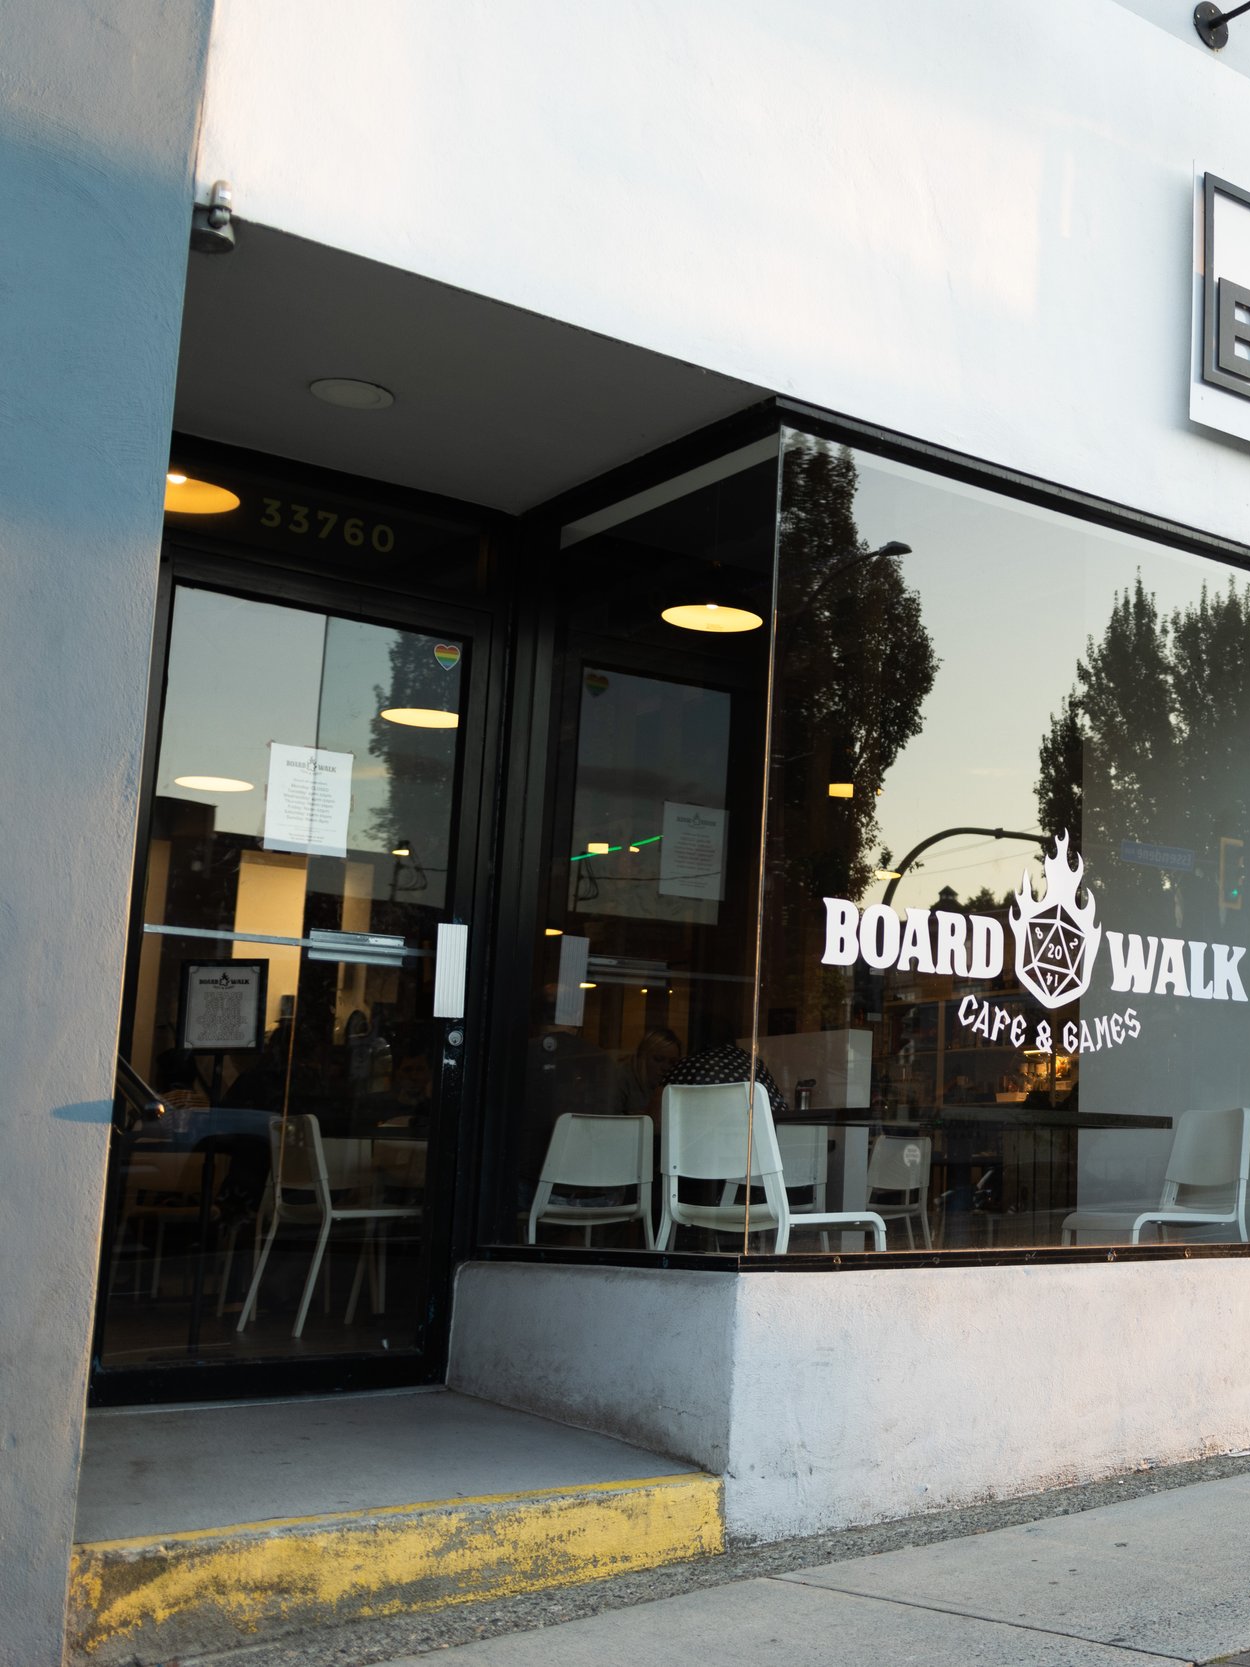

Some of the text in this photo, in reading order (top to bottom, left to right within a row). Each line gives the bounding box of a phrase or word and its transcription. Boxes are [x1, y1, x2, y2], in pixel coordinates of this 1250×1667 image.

[260, 497, 395, 553] 33760
[1034, 926, 1044, 940] 8
[820, 897, 1249, 1002] BOARD WALK
[1047, 943, 1063, 960] 20
[1069, 937, 1079, 950] 2
[1046, 972, 1059, 987] 14
[956, 994, 1142, 1055] CAFE & GAMES
